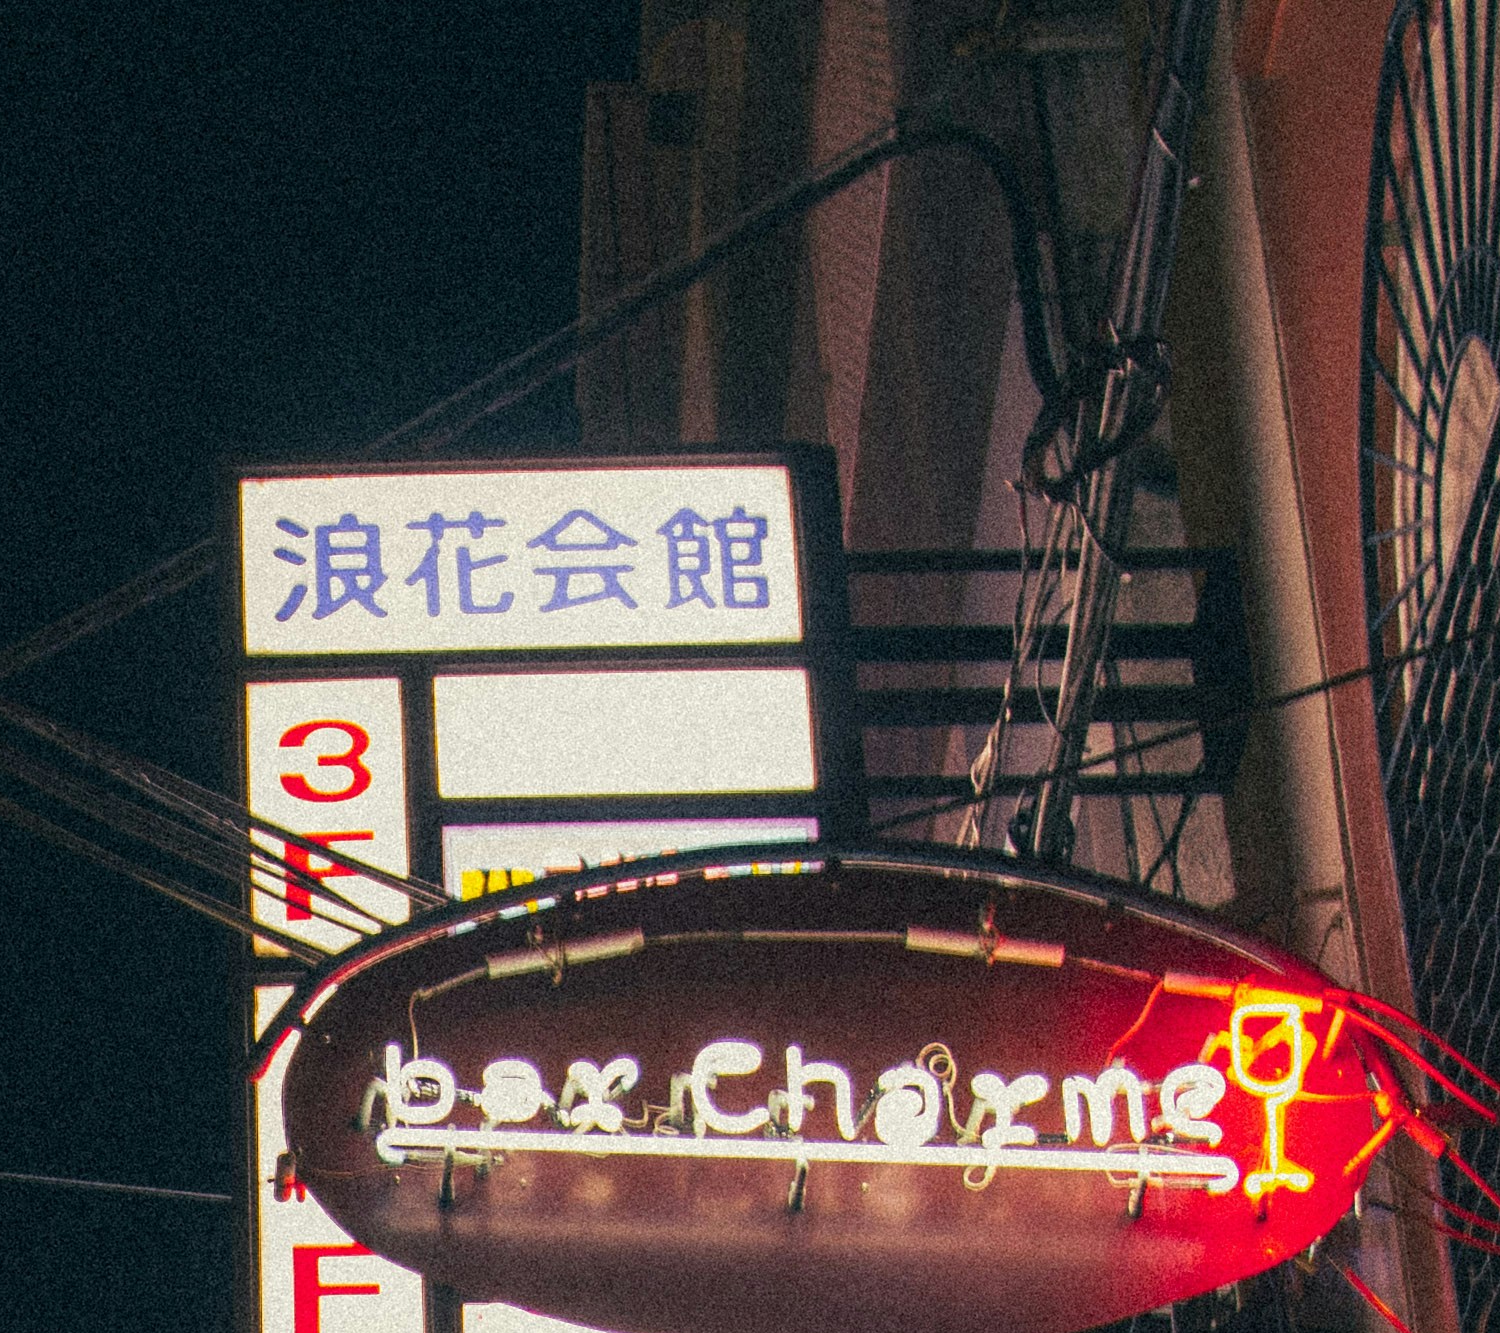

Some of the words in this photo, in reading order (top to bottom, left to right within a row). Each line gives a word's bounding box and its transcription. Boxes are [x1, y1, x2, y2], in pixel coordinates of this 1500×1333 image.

[272, 506, 771, 623] 浪花会館
[382, 1040, 639, 1132] bar
